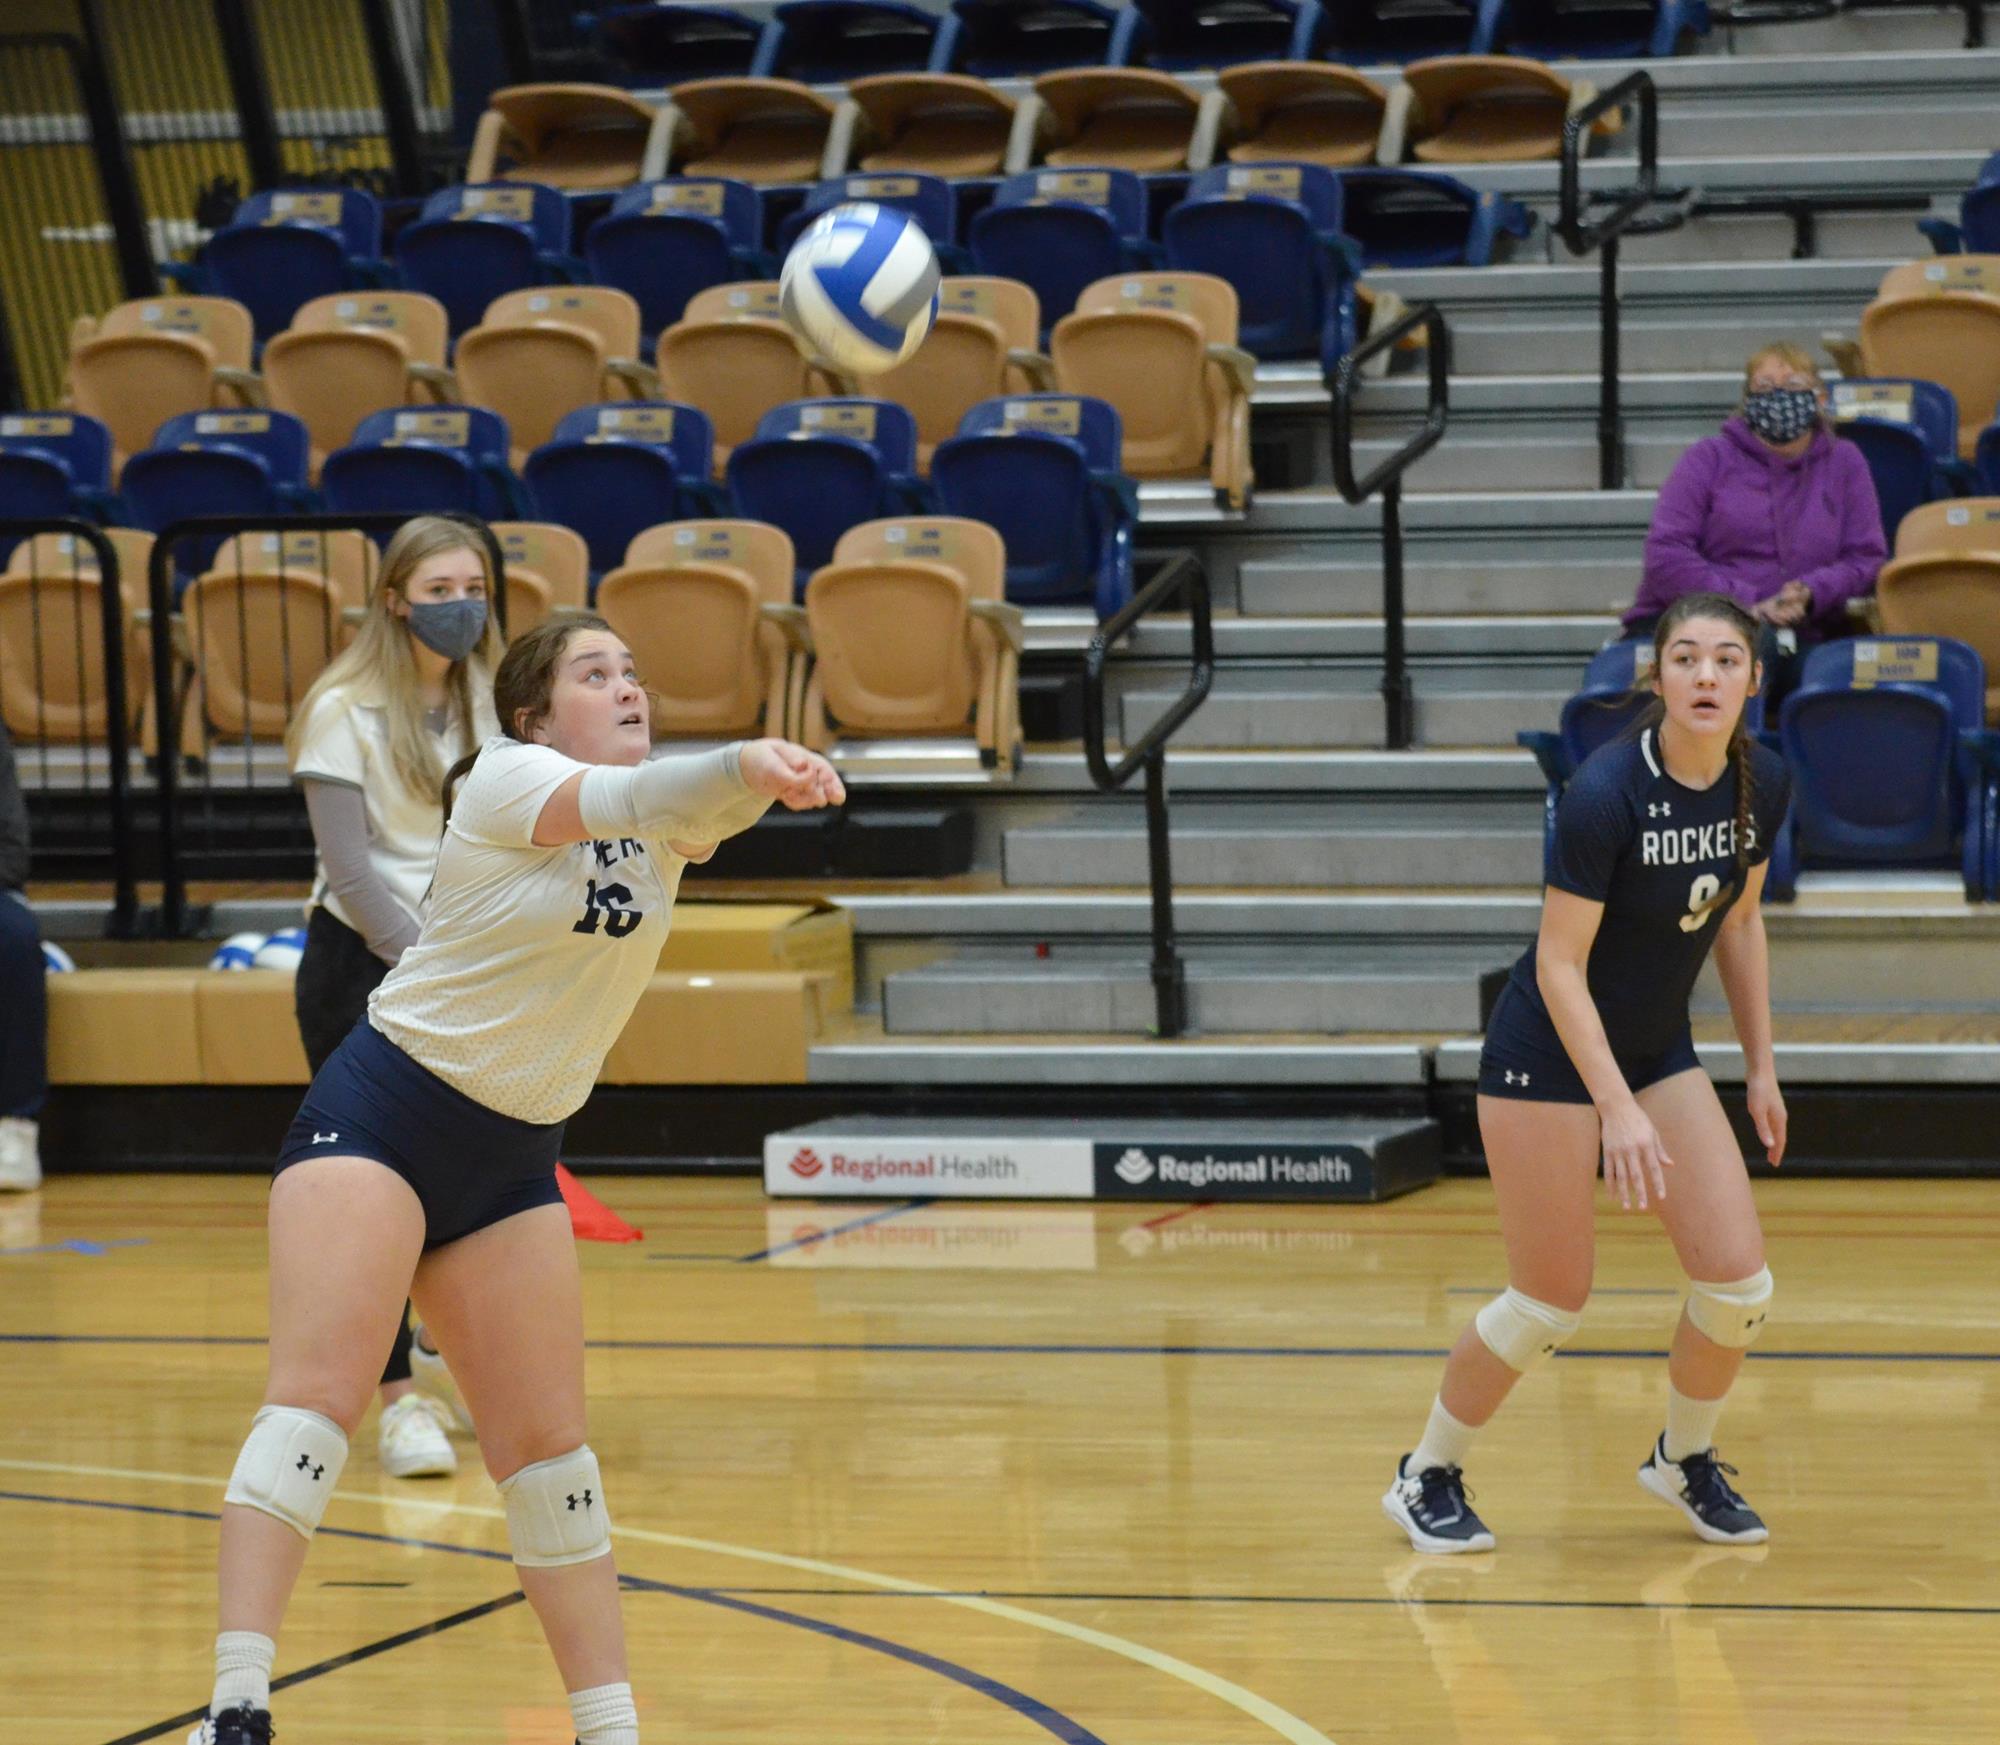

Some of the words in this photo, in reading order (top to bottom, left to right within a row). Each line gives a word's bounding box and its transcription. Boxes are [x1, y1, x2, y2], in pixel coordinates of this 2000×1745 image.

[572, 879, 643, 938] 16
[1678, 873, 1720, 933] 9
[831, 1154, 935, 1181] Regional
[940, 1156, 1018, 1179] Health
[1158, 1155, 1267, 1187] Regional
[1271, 1157, 1351, 1183] Health
